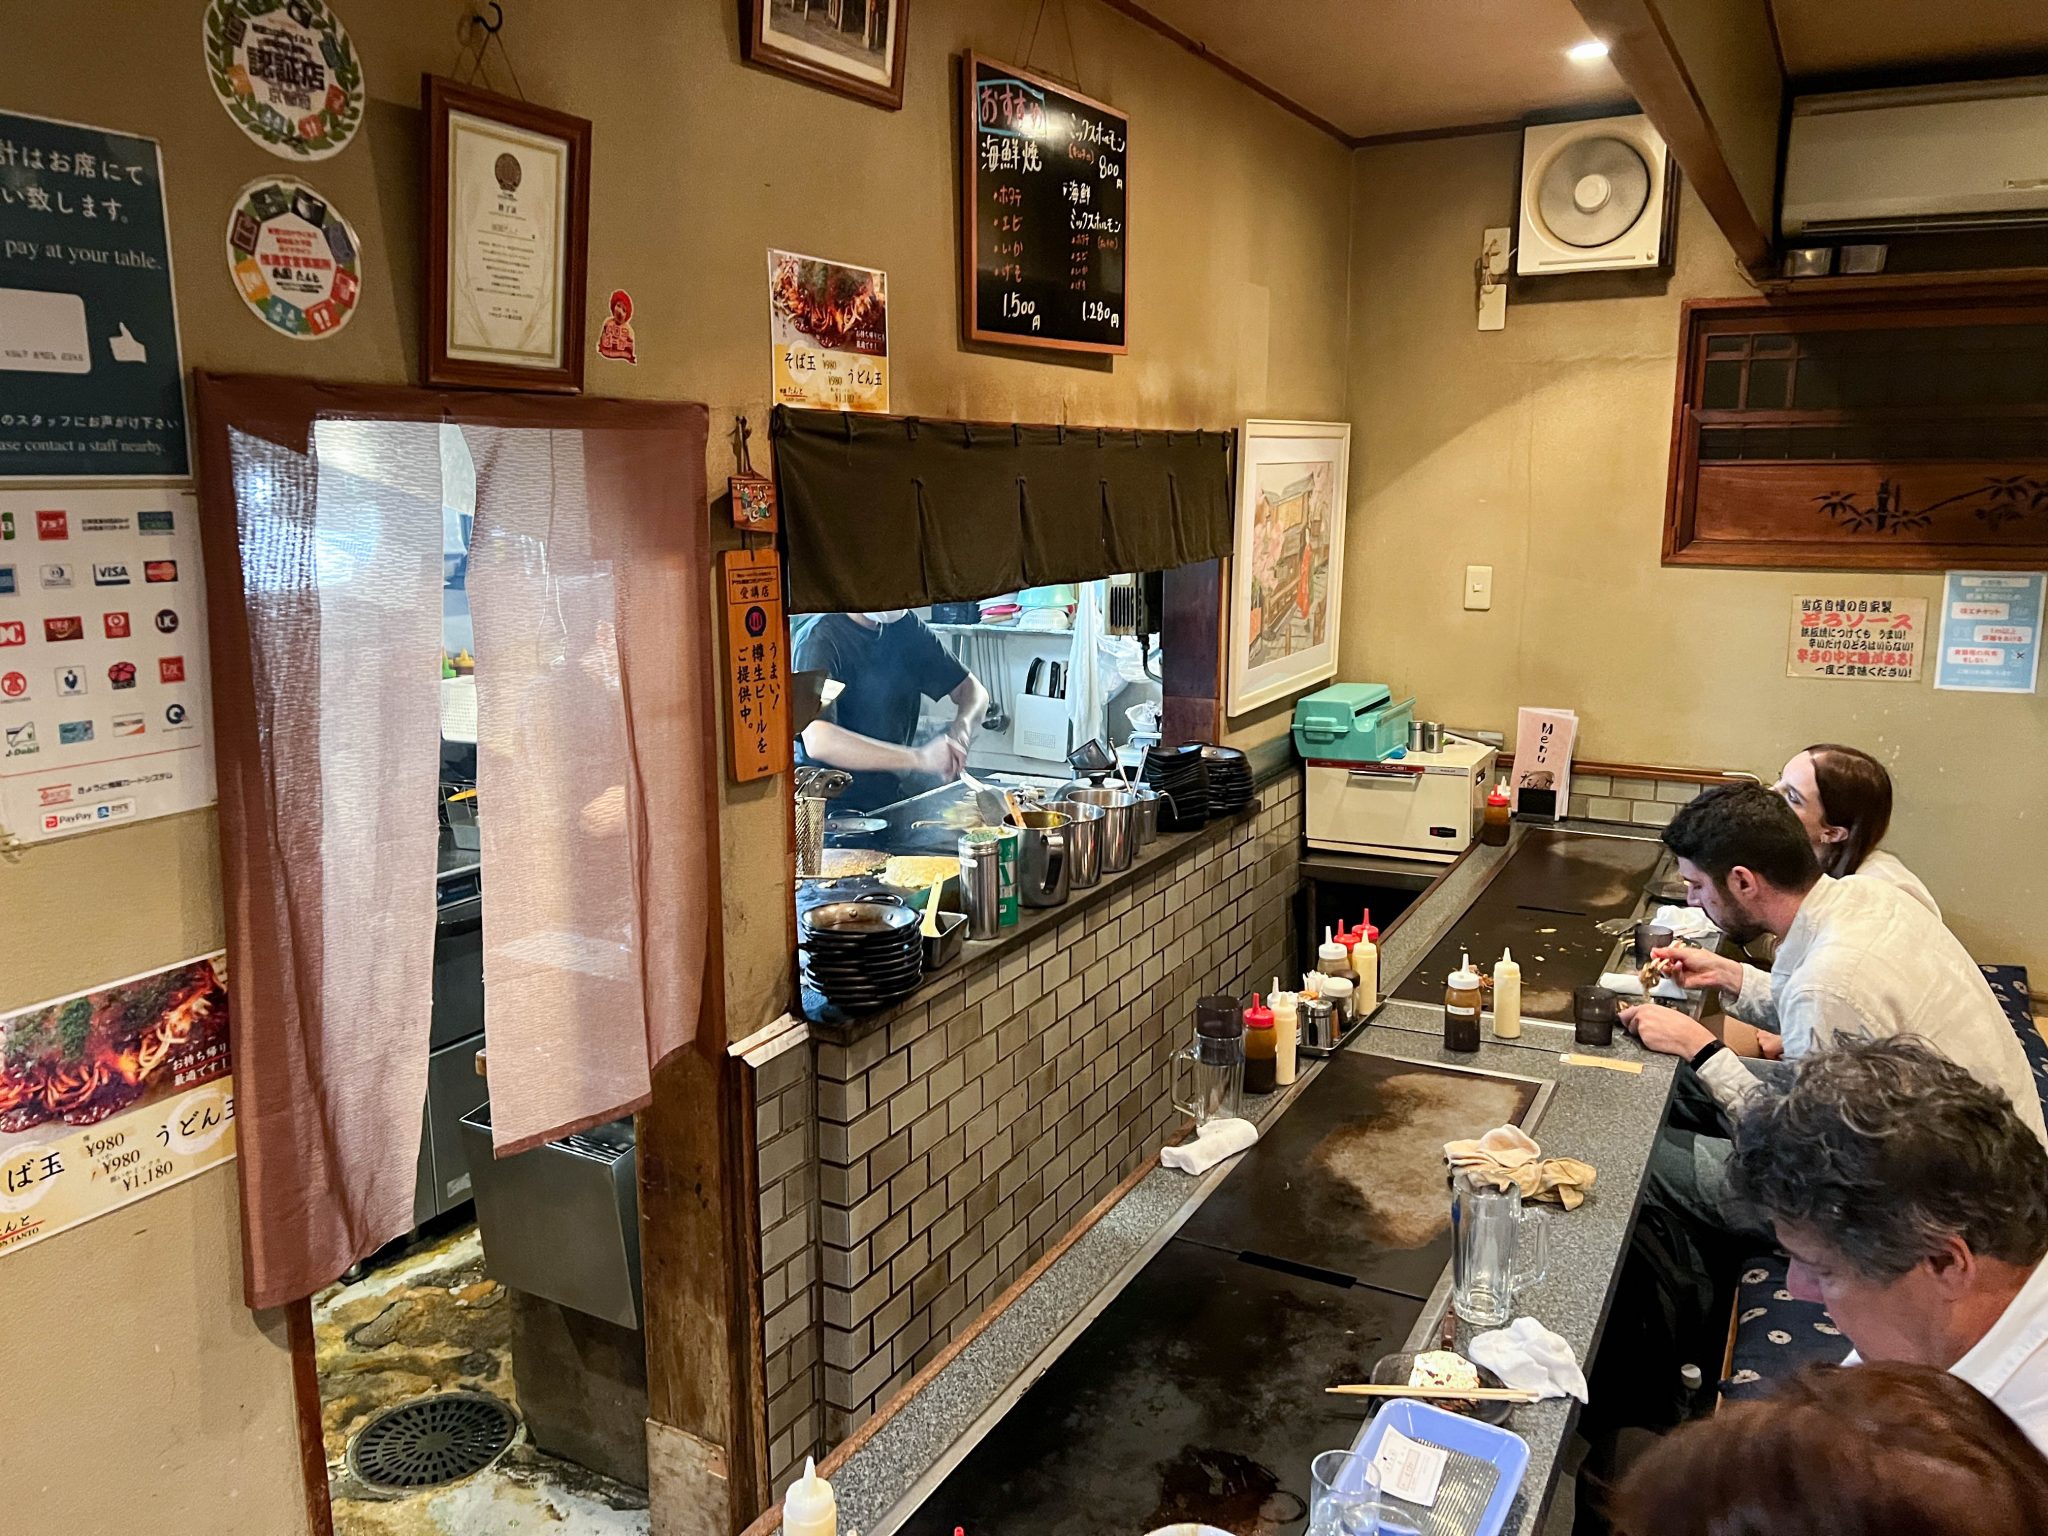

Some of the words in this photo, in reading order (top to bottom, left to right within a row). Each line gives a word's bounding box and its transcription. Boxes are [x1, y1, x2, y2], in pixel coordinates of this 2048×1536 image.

[981, 134, 1042, 174] 海鮮焼
[2, 186, 129, 224] い致します。
[5, 240, 39, 260] pay
[46, 244, 62, 259] at
[69, 246, 109, 265] your
[115, 251, 163, 270] table.
[785, 352, 816, 372] そば玉
[848, 369, 882, 386] うどん玉
[24, 440, 74, 451] contact
[99, 565, 128, 578] VISA
[1801, 599, 1892, 613] 当店自慢の自家製
[1800, 611, 1913, 631] どろソース
[737, 646, 754, 729] ご提供中。
[752, 643, 768, 754] 樽生ビールを
[1537, 722, 1553, 763] Menu
[59, 812, 92, 824] PayPay
[86, 1133, 124, 1158] ¥980
[8, 1152, 65, 1192] ば玉
[102, 1149, 140, 1174] ¥980
